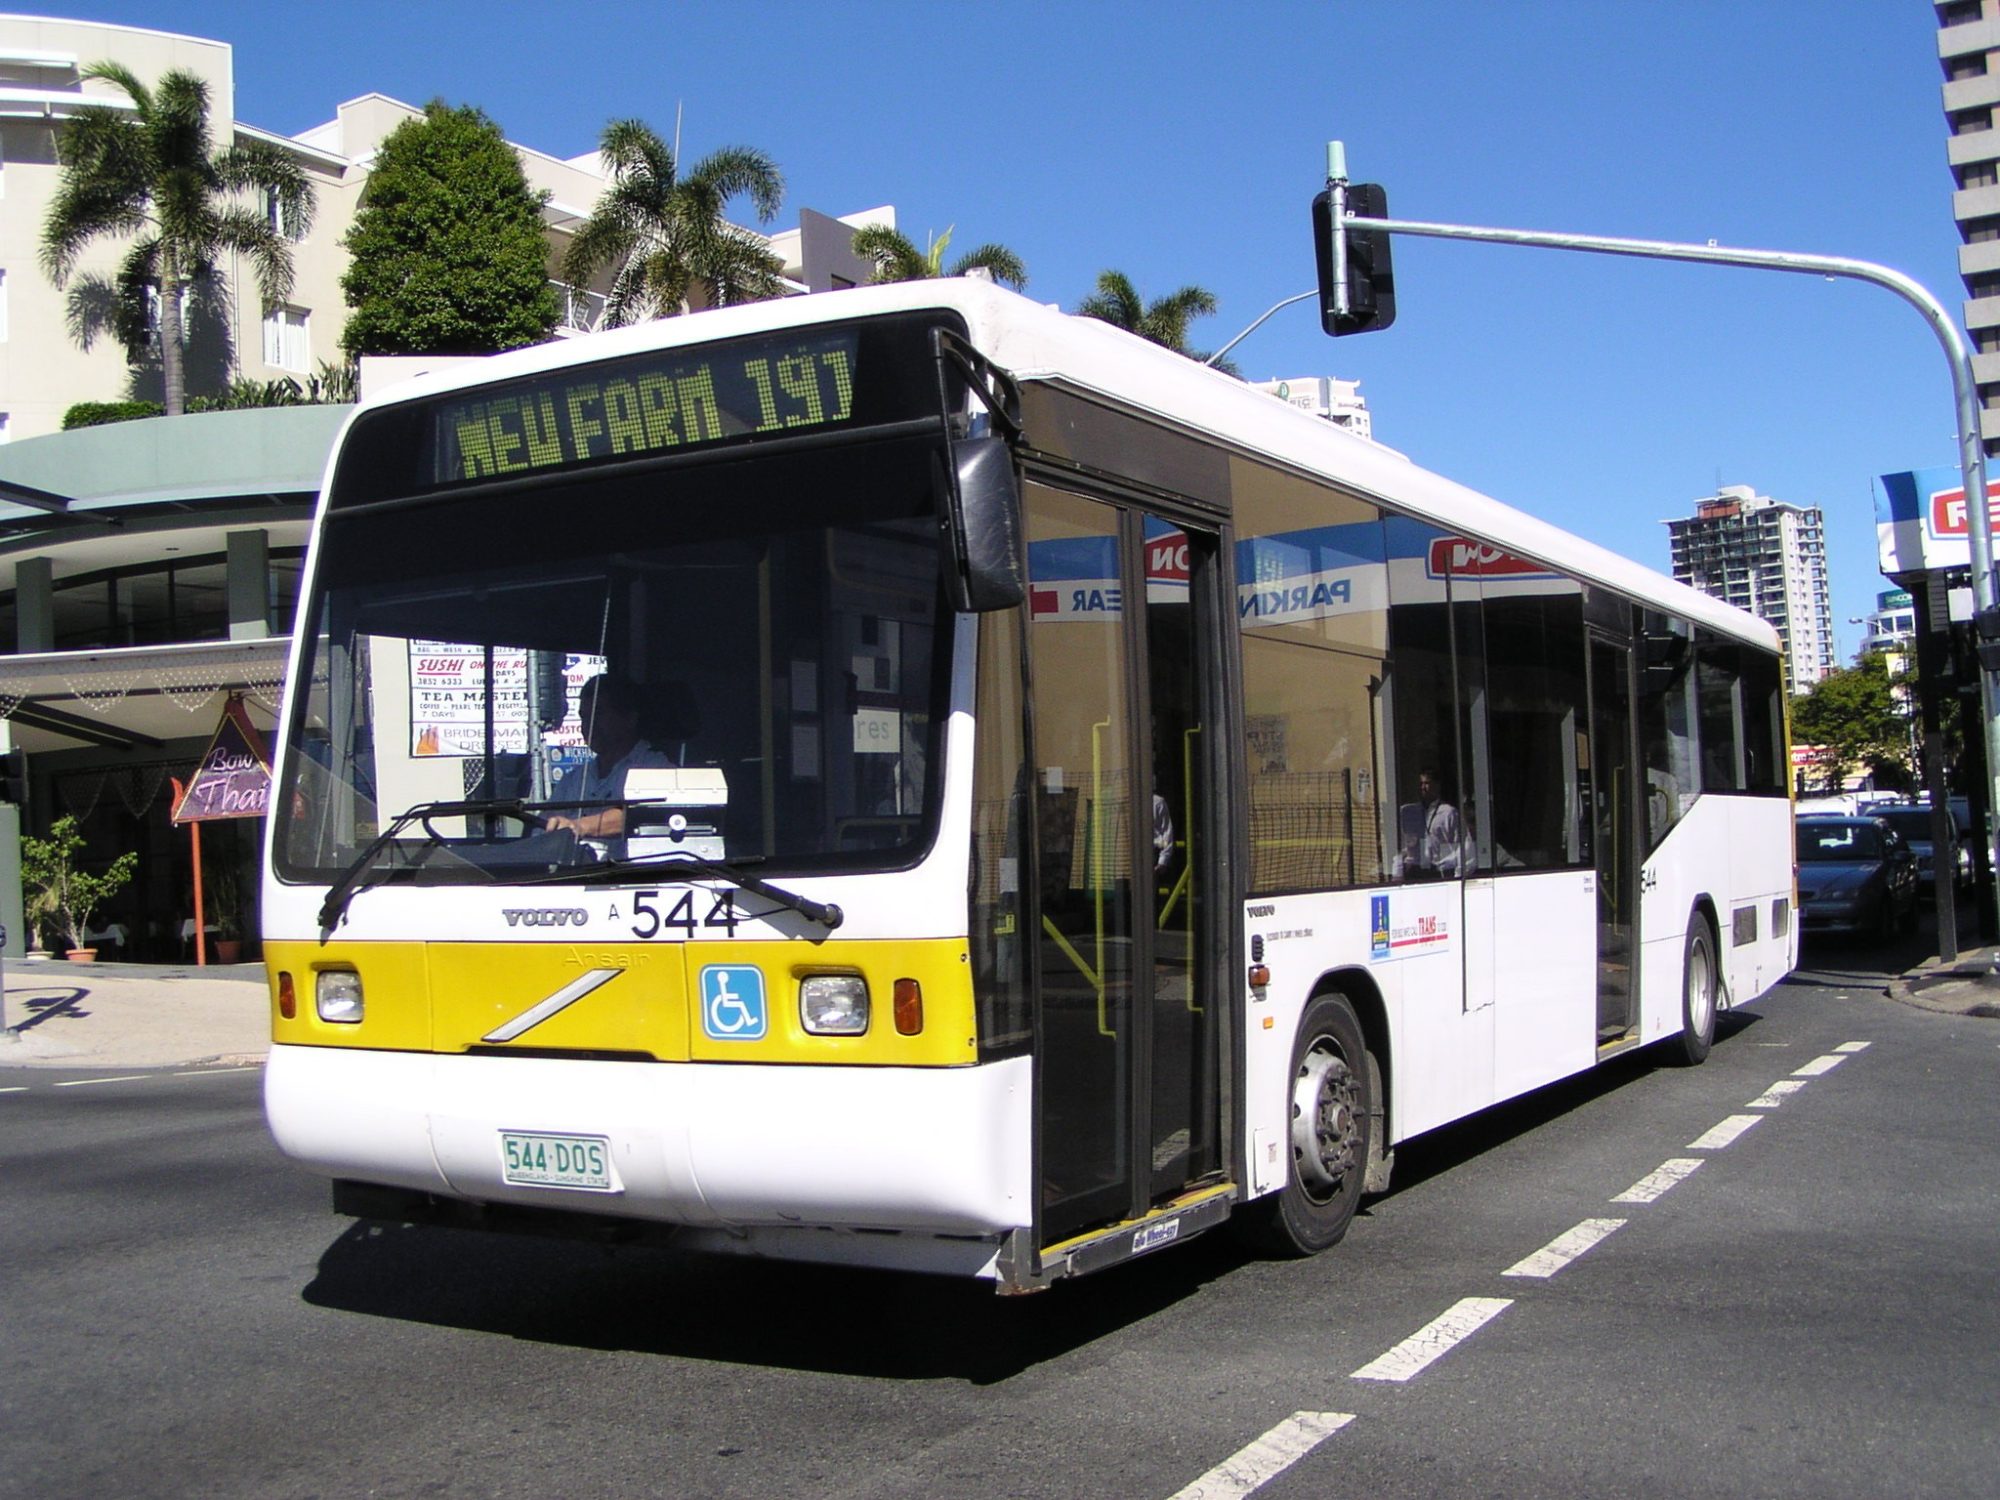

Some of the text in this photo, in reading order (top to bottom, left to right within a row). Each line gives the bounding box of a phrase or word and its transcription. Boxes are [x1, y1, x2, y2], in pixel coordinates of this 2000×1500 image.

[566, 363, 722, 460] FARM
[417, 659, 465, 672] SUSHI
[493, 660, 508, 669] HE
[512, 660, 527, 669] RU
[421, 691, 454, 701] TEA
[443, 728, 528, 739] BRIDEMAI
[209, 747, 253, 771] Bow
[195, 771, 269, 814] Thai
[502, 889, 739, 939] VOLVO A 544
